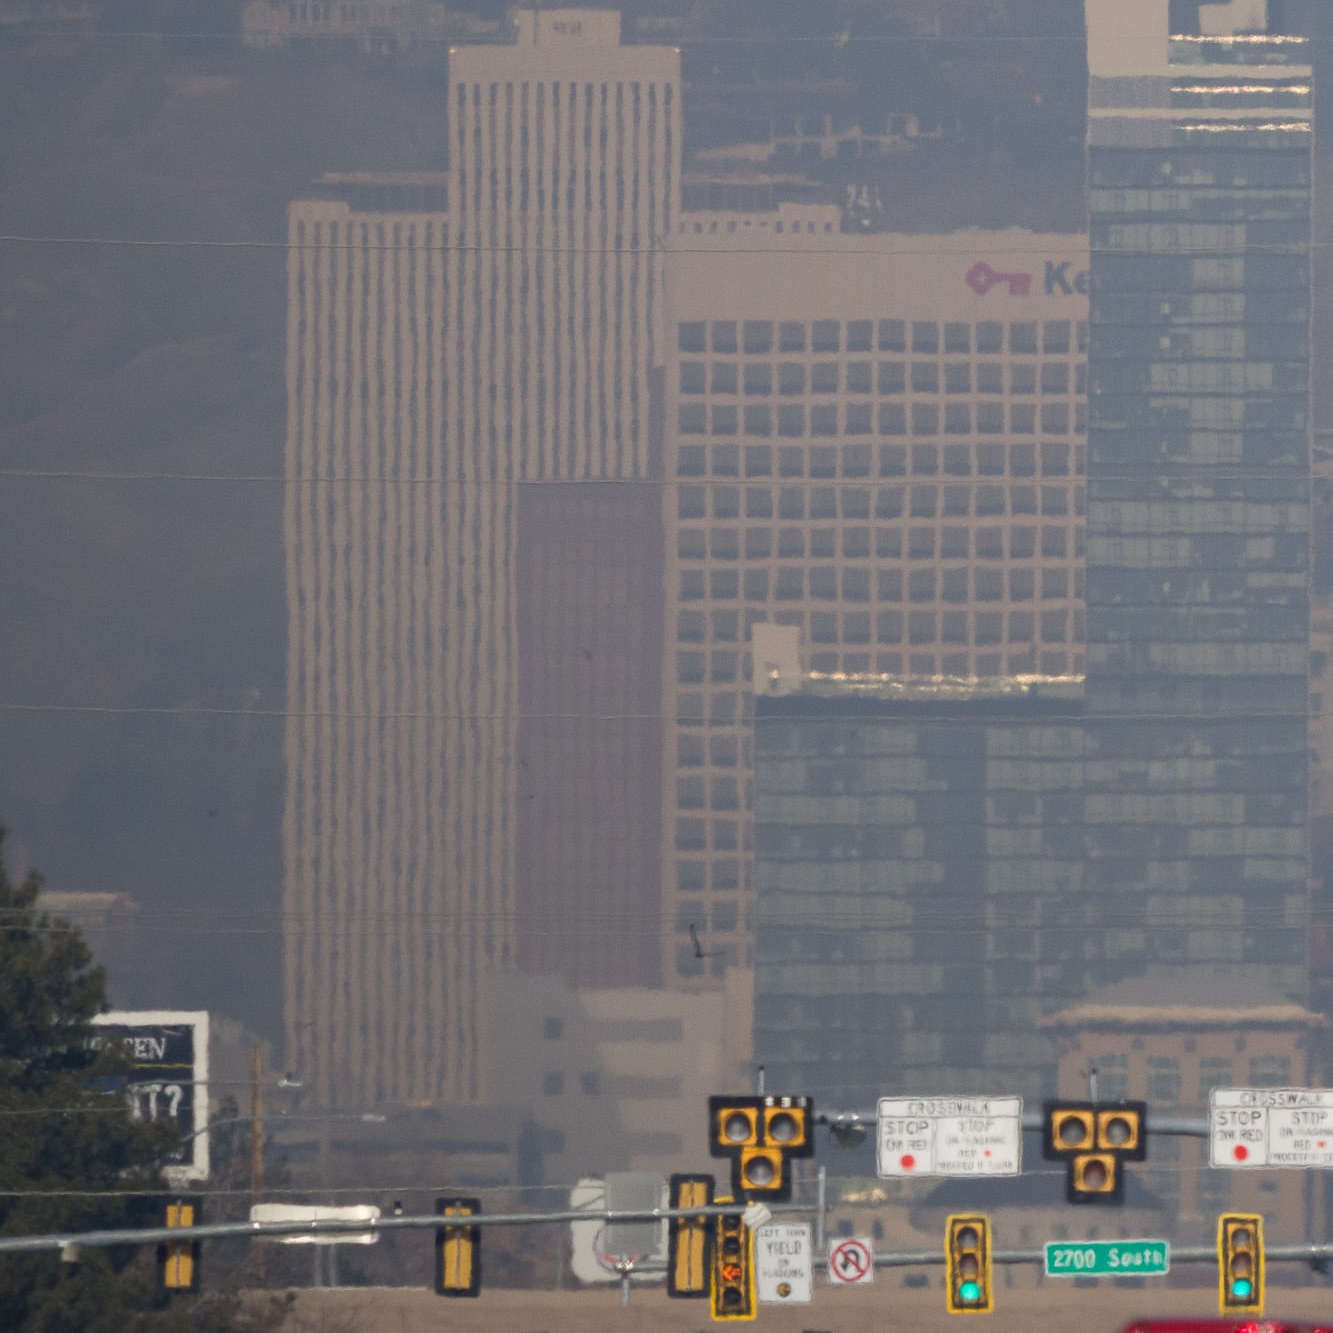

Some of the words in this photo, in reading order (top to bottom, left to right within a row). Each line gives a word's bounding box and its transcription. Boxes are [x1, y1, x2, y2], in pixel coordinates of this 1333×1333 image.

[1217, 1111, 1262, 1126] STOP
[1291, 1111, 1328, 1124] STOP
[885, 1119, 930, 1135] STOP
[1240, 1129, 1263, 1141] RED
[767, 1240, 802, 1255] YIELD
[1053, 1249, 1096, 1269] 2700
[1107, 1247, 1163, 1268] South
